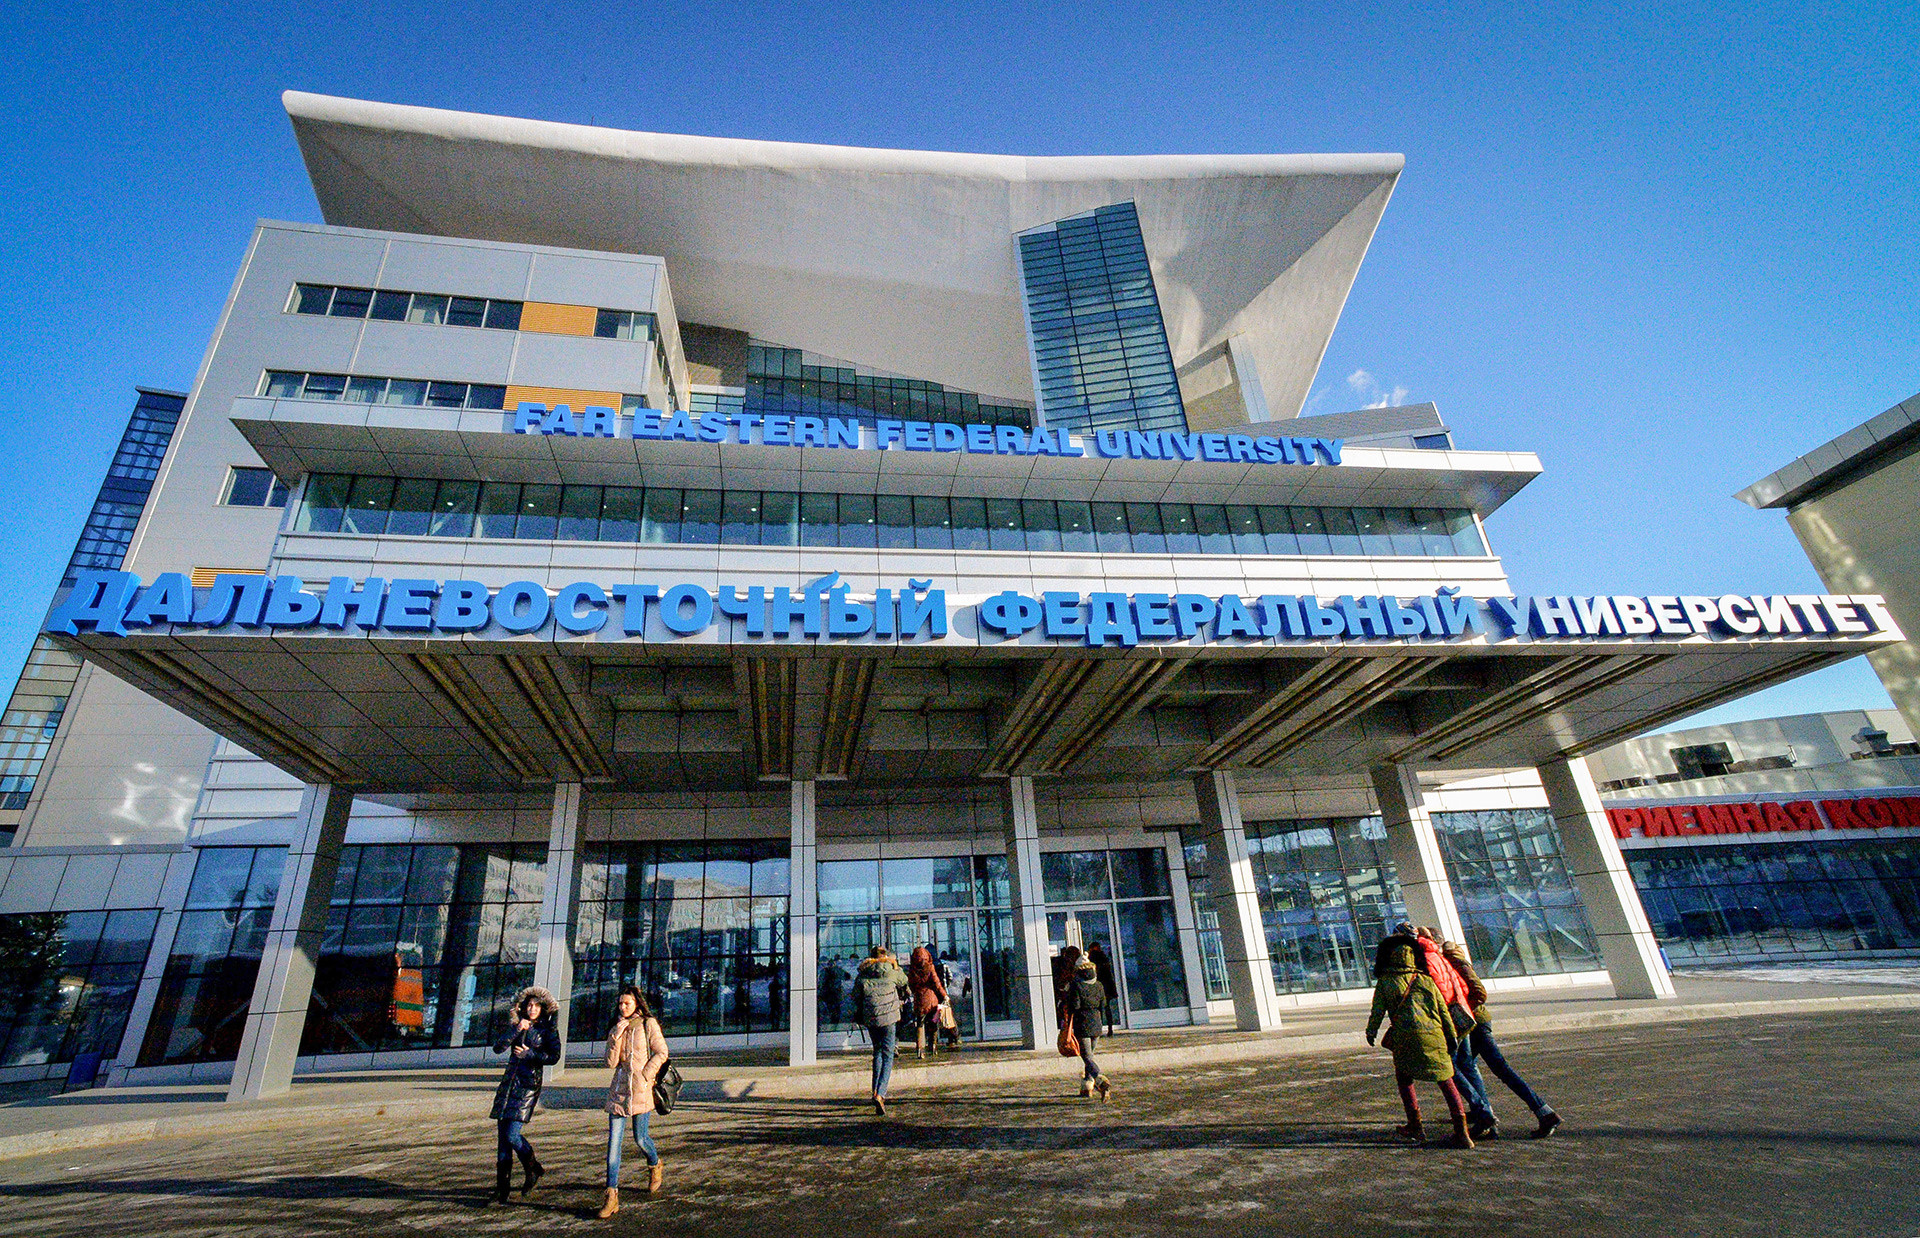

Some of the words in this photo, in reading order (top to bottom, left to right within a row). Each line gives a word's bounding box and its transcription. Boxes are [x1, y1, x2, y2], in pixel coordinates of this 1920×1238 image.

[515, 402, 613, 437] FAR
[633, 409, 859, 448] EASTERN
[876, 420, 1083, 456] FEDERAL
[1097, 431, 1344, 465] UNIVERSITY
[46, 571, 946, 637] ДАЛЬНЕВОСТОЧНЫЙ
[982, 585, 1487, 646] ФЕДЕРАЛЬНЫЙ
[1487, 595, 1899, 637] УНИВЕРСИТЕТ
